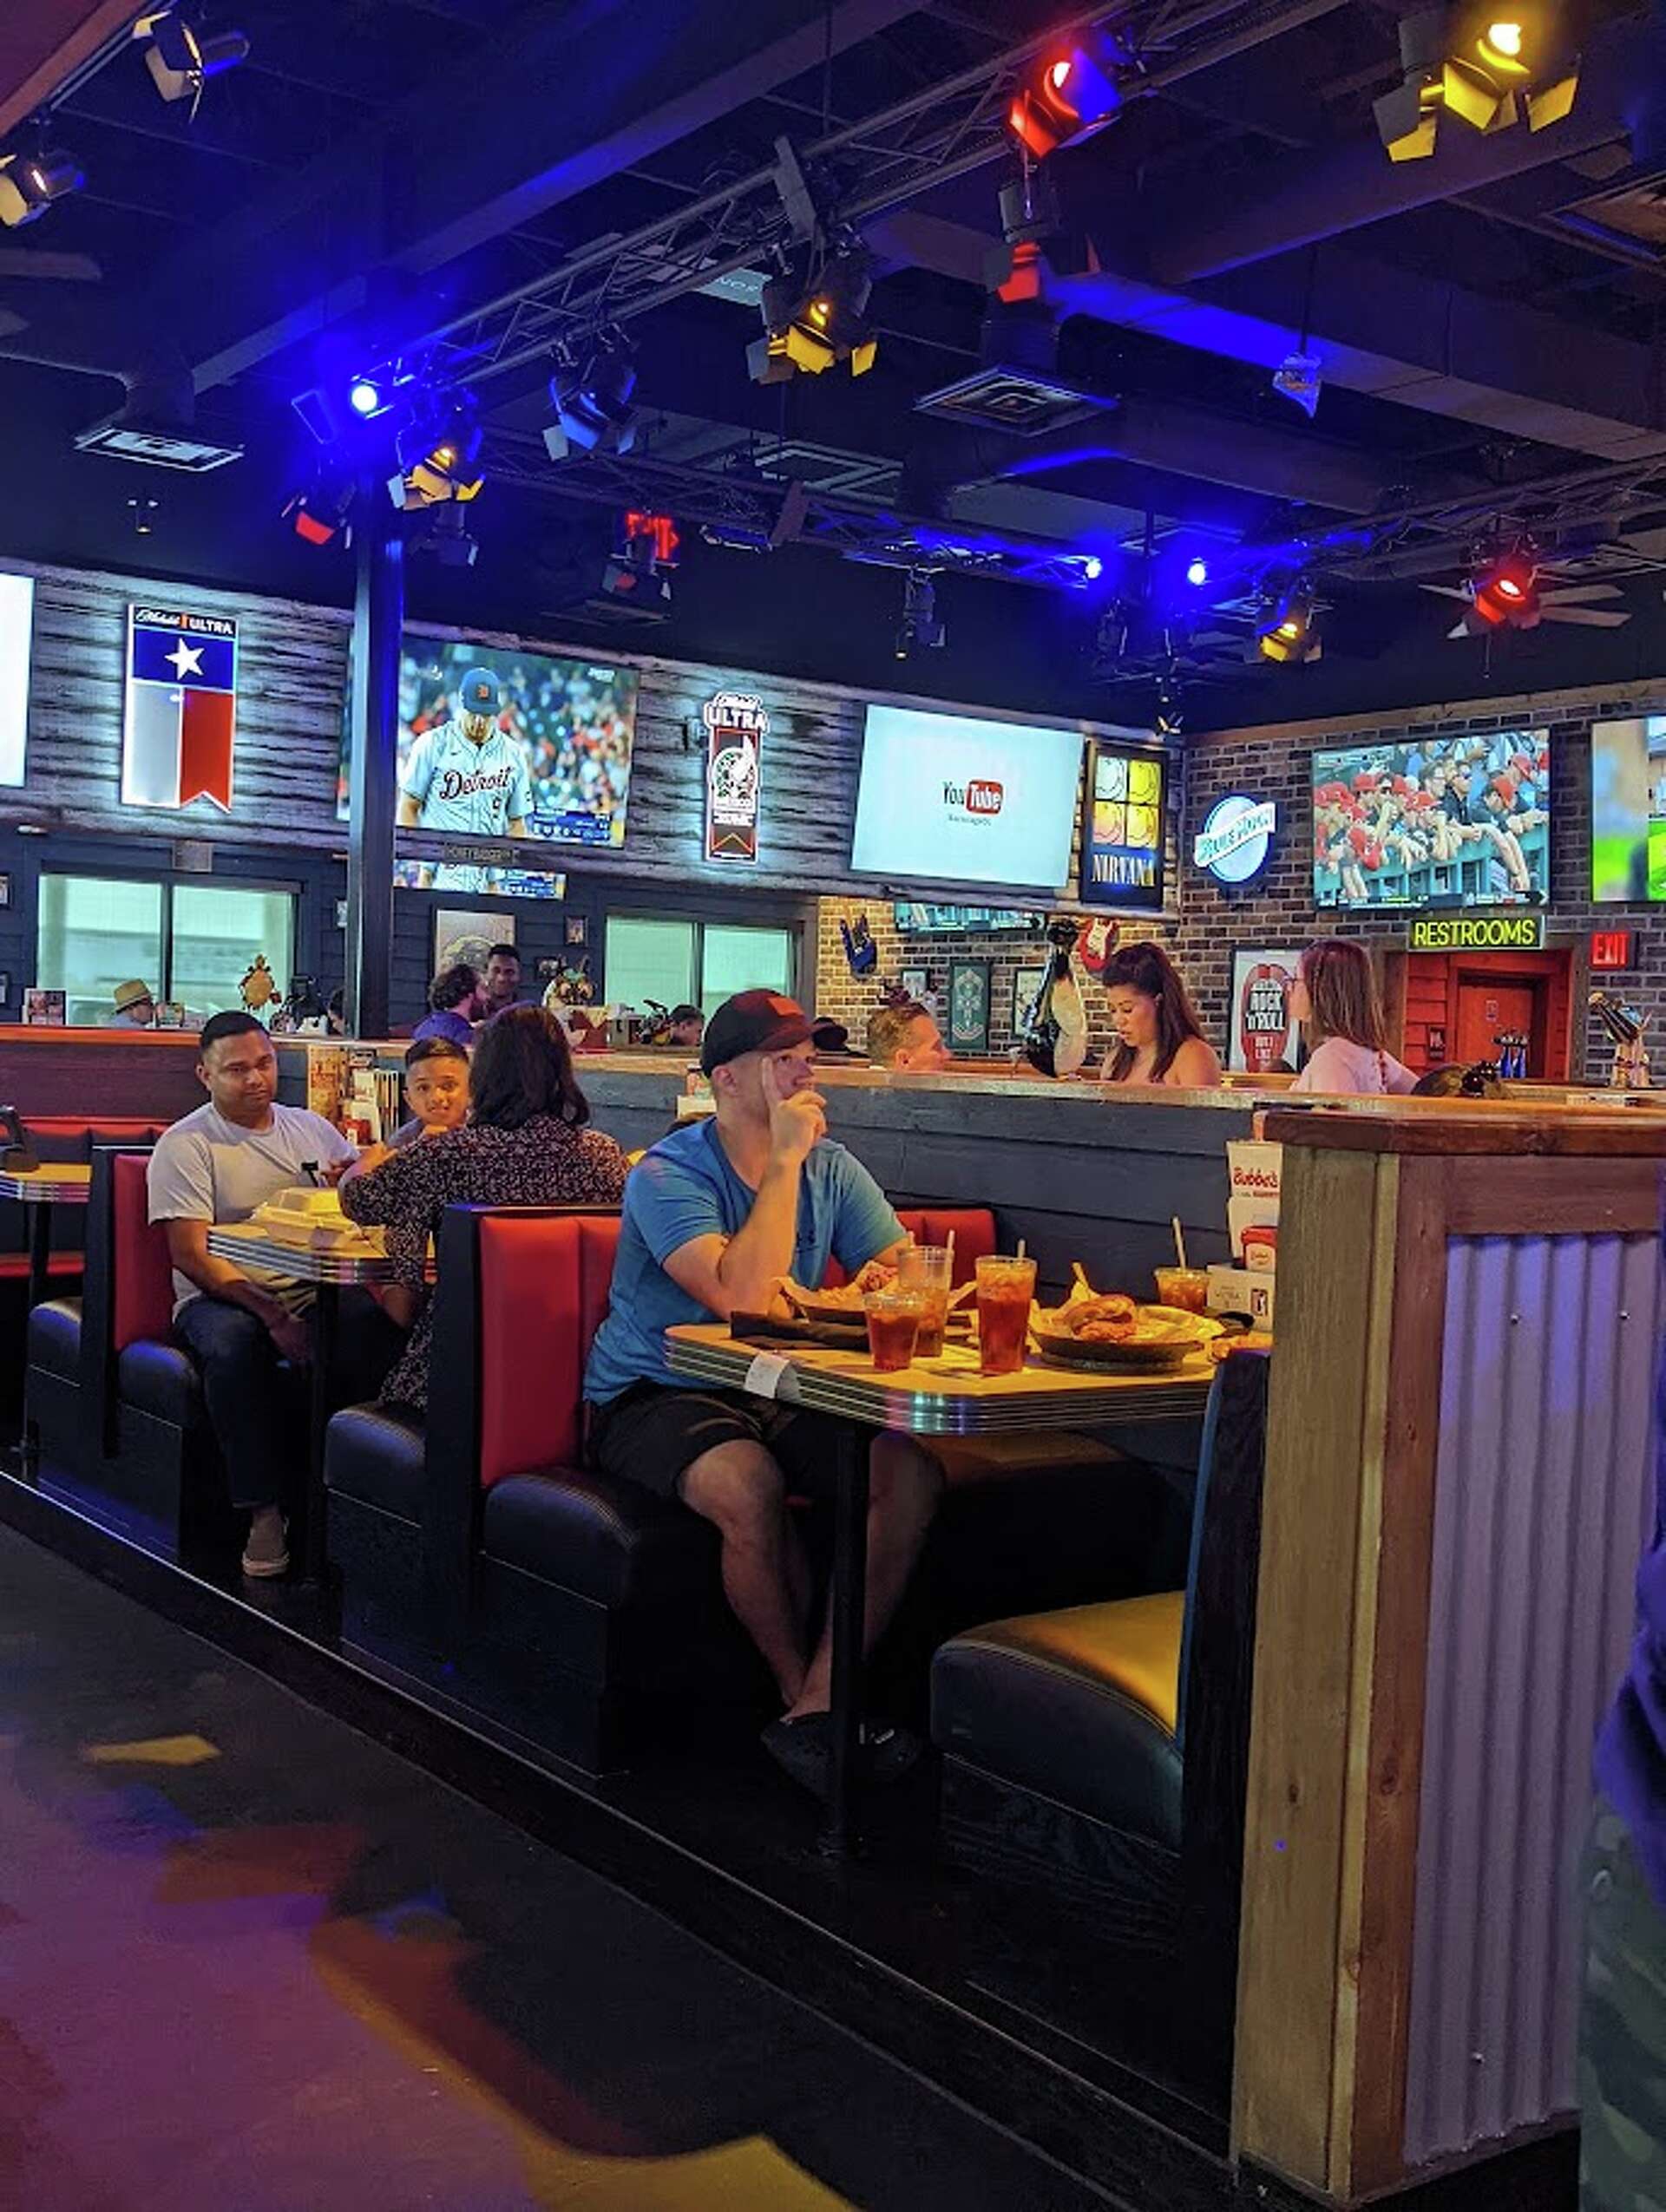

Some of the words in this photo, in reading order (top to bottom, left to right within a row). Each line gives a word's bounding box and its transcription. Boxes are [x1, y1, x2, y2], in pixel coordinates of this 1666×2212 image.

[188, 618, 233, 635] ULTRA
[707, 705, 766, 732] ULTRA
[439, 767, 514, 800] Detroit
[942, 781, 1001, 812] YouTube
[1092, 854, 1154, 887] NIRVANA
[1414, 919, 1535, 946] RESTROOMS
[1592, 933, 1628, 965] EXIT
